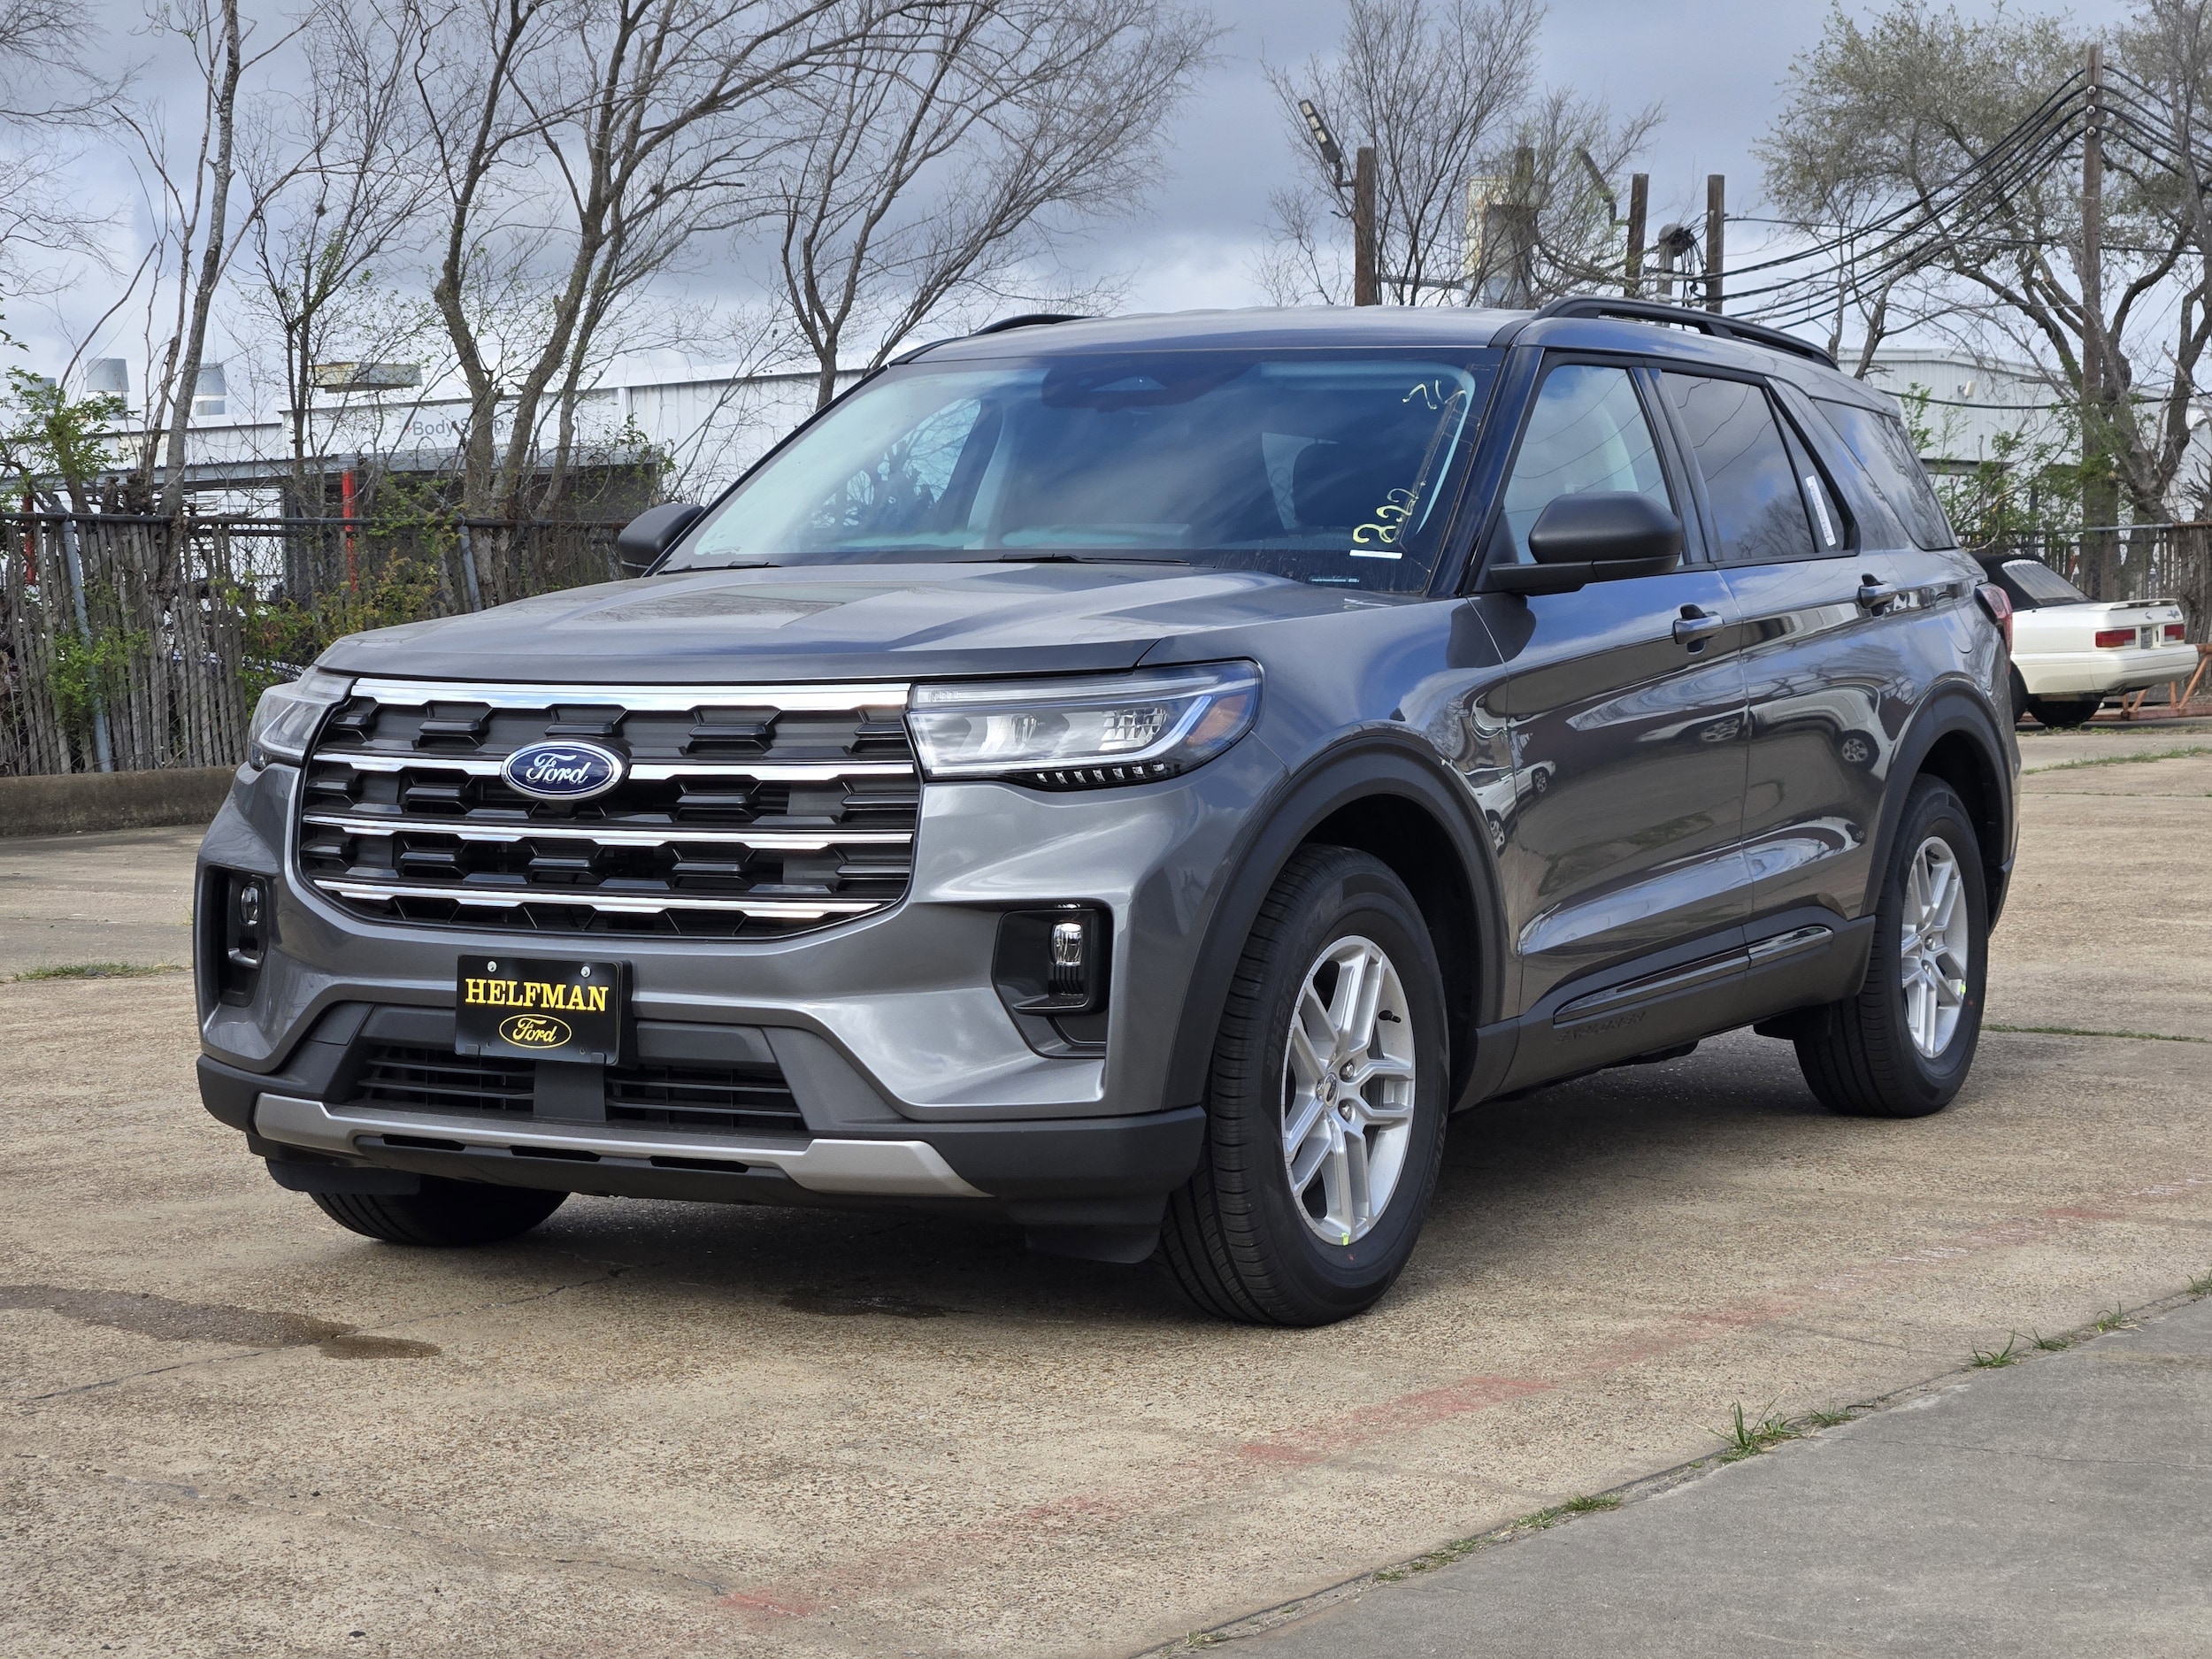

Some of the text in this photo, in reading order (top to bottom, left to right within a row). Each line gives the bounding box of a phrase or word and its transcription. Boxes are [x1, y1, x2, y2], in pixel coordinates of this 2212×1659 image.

[412, 418, 503, 437] Body Sp
[526, 752, 592, 785] Ford
[465, 978, 610, 1012] HELFMAN
[511, 1017, 558, 1043] Ford
